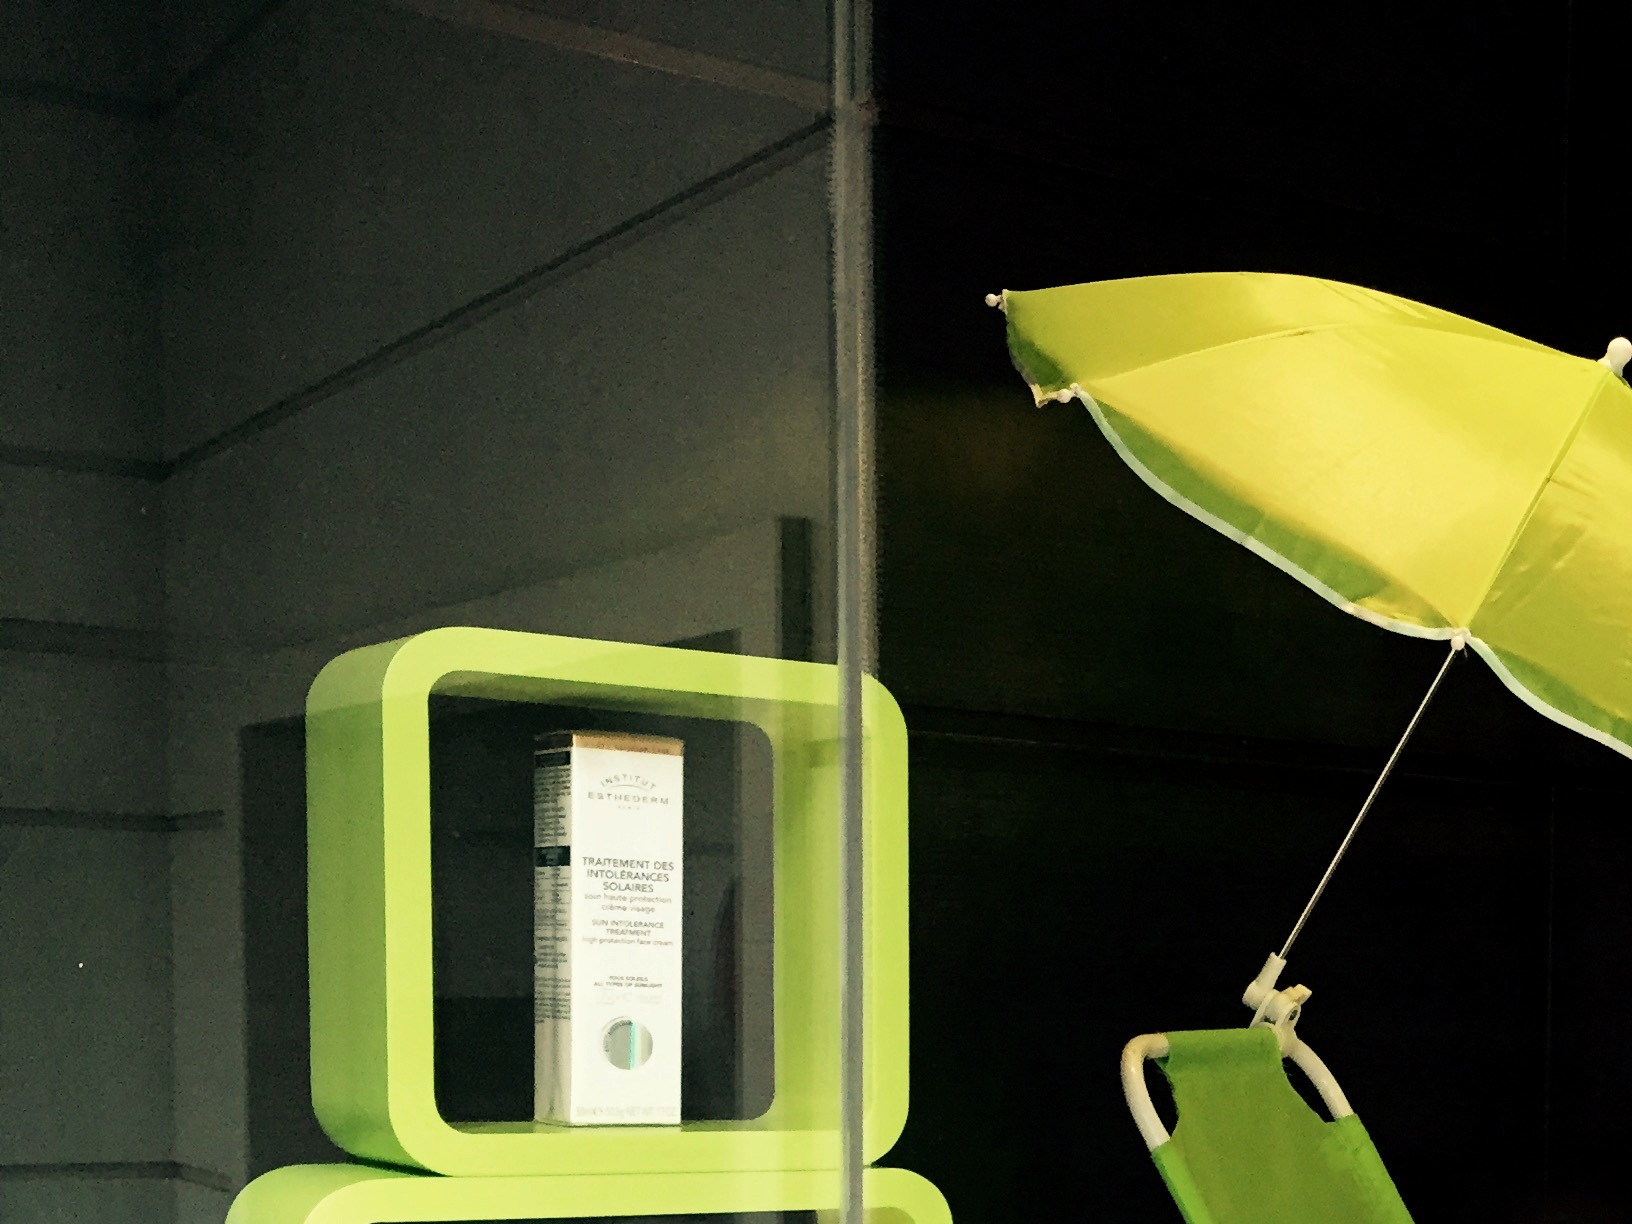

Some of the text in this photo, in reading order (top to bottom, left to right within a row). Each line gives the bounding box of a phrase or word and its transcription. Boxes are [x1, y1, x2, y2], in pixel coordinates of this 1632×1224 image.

[601, 773, 656, 789] INSTITUT
[587, 791, 669, 805] ESTHEDERM
[582, 856, 675, 871] TRAITEMENT DES
[602, 881, 655, 893] SOLAIRES
